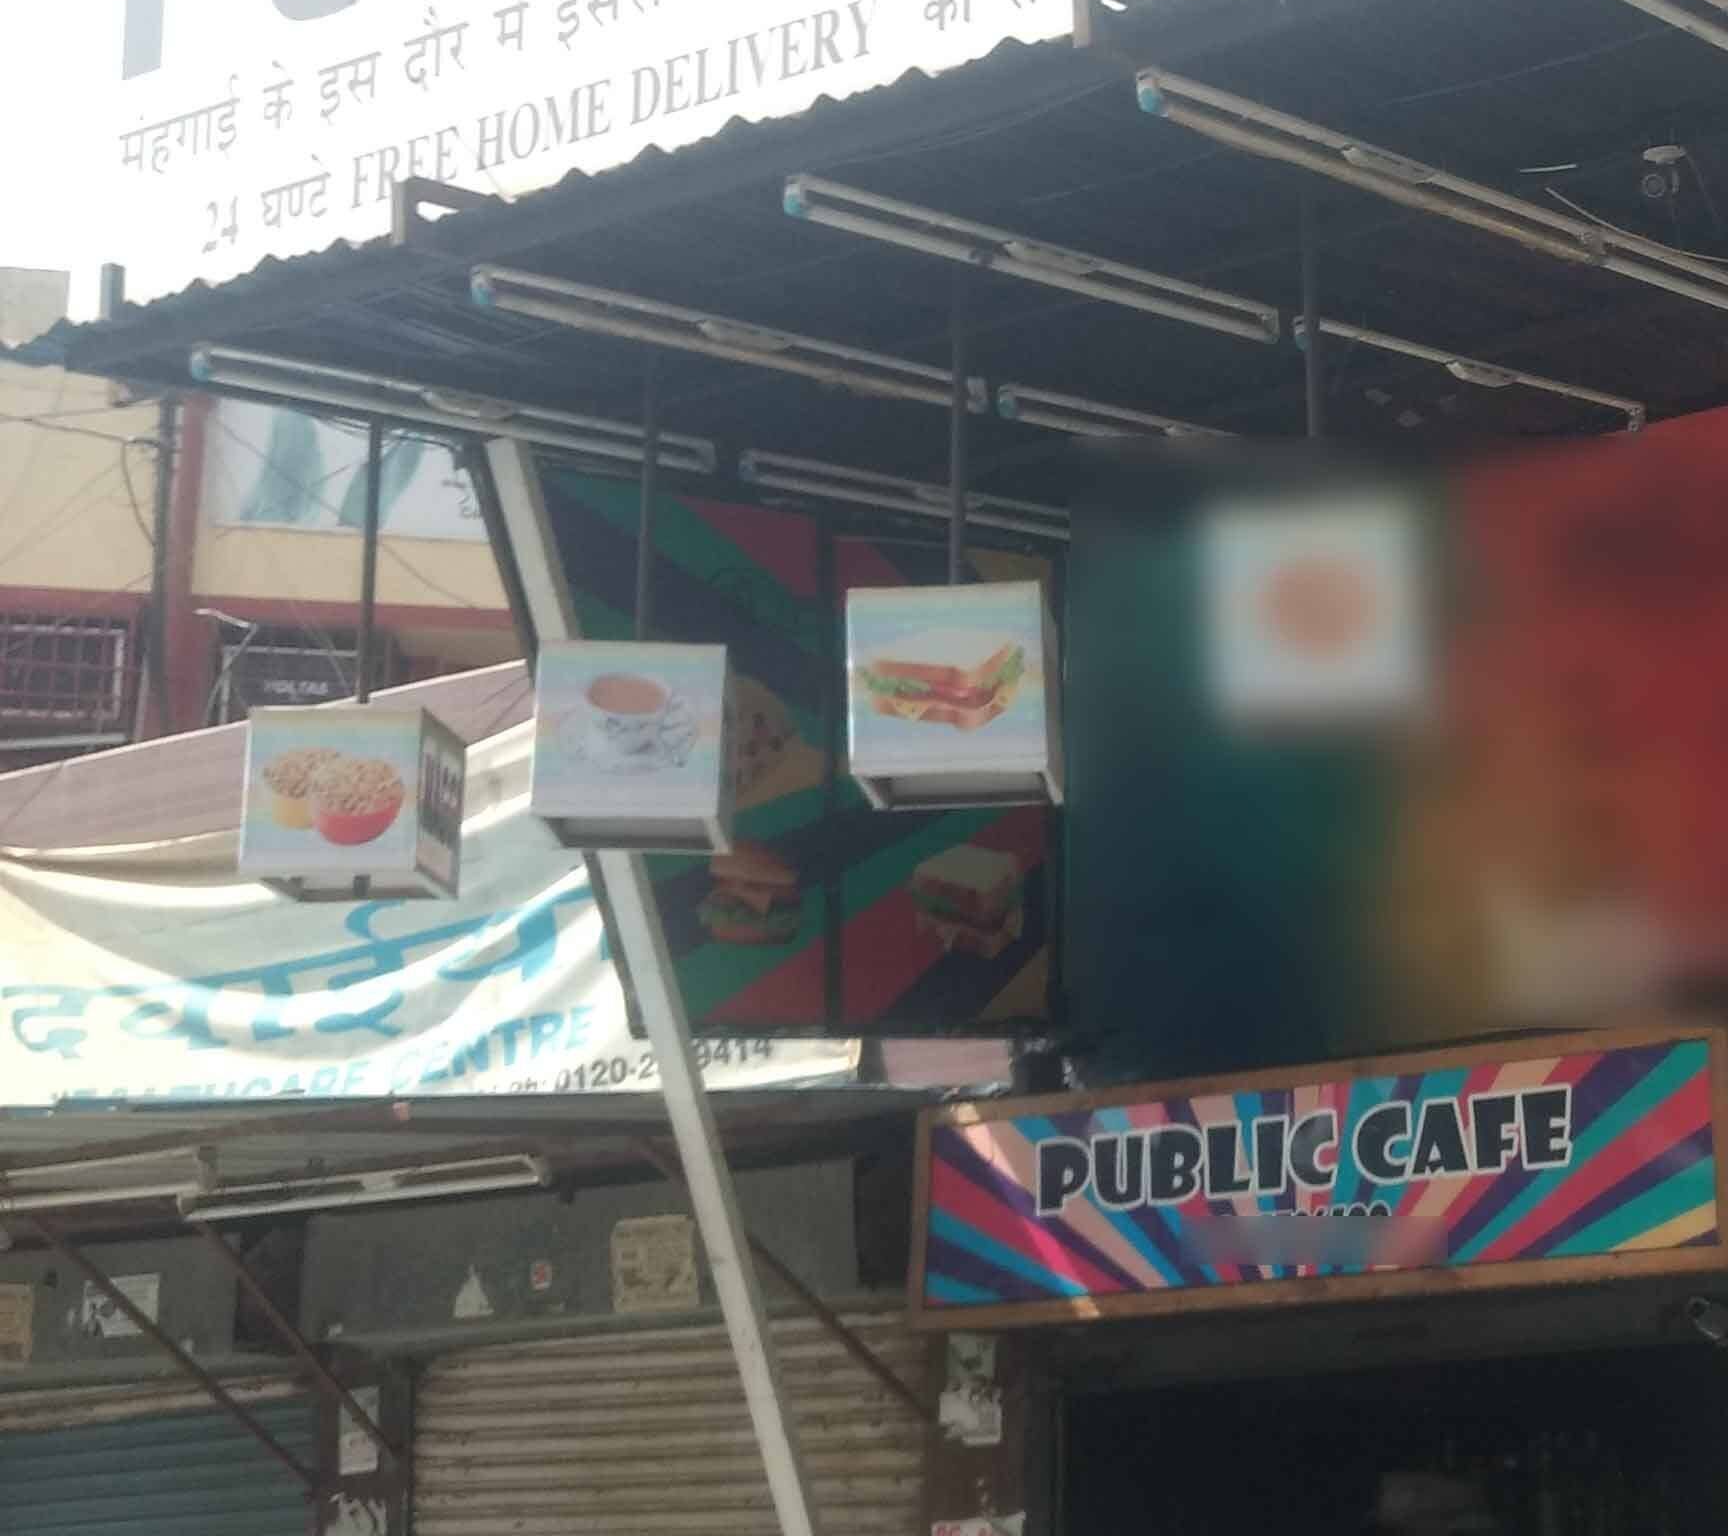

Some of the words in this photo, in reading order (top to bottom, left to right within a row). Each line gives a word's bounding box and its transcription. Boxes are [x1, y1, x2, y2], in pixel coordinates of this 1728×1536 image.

[263, 60, 294, 129] के
[318, 51, 382, 126] इस
[351, 125, 459, 209] FREE
[476, 79, 611, 172] HOME
[1036, 1111, 1339, 1217] PUBLIC
[1352, 1085, 1573, 1188] CAFE
